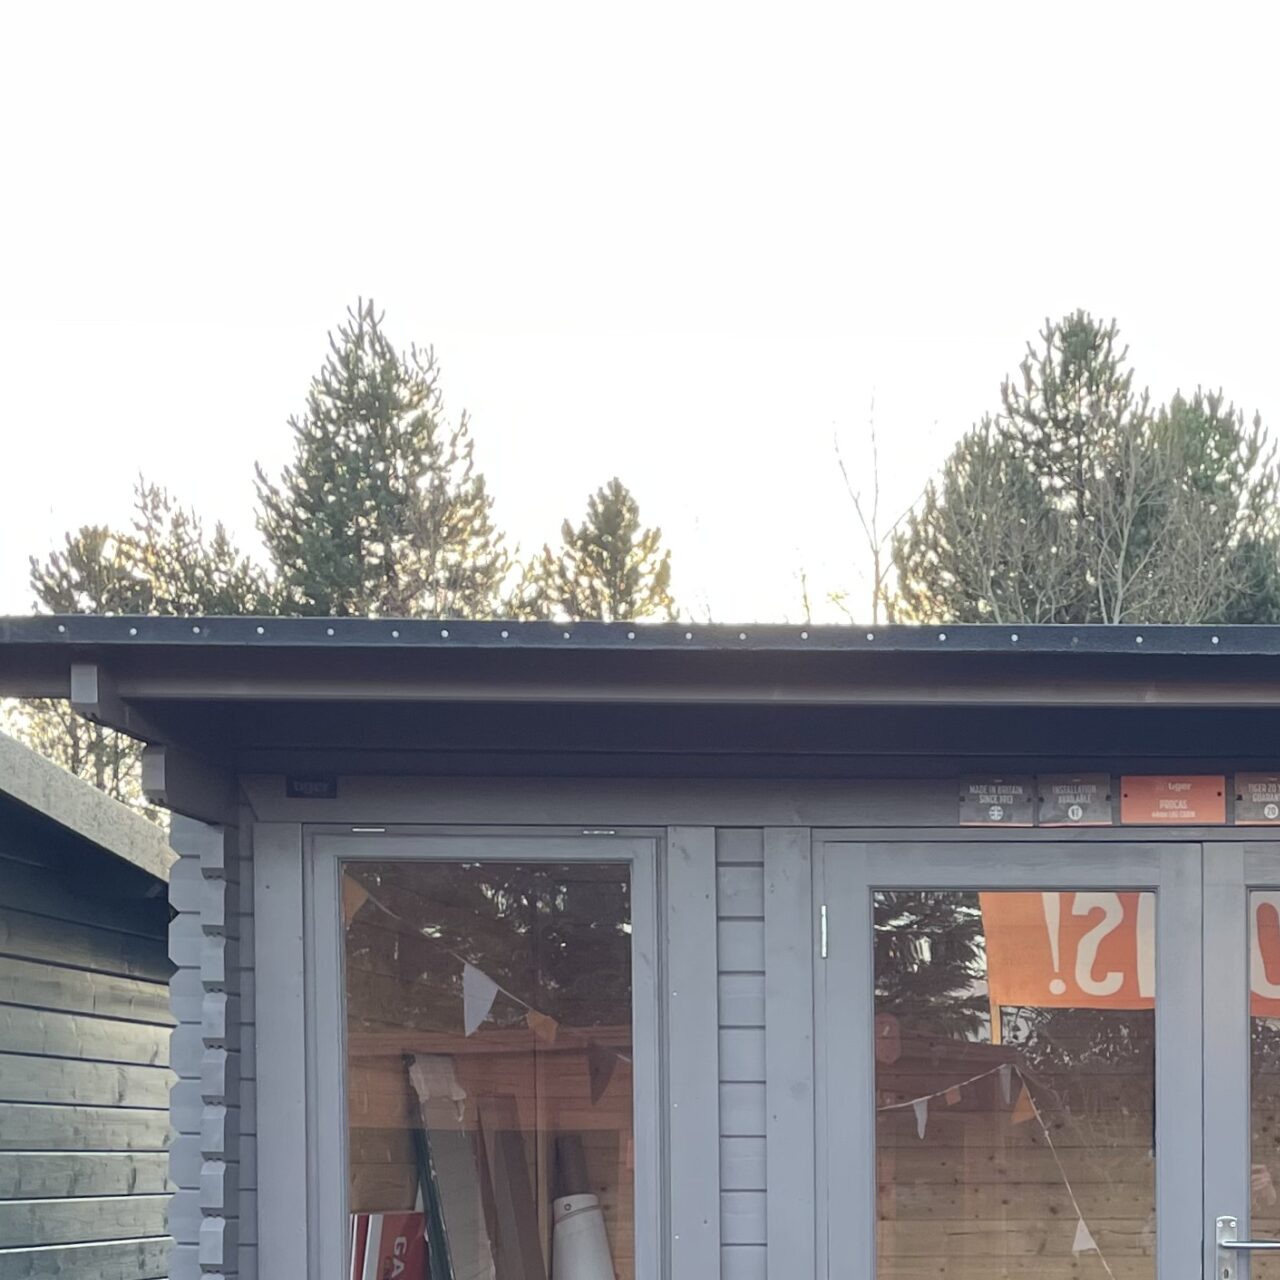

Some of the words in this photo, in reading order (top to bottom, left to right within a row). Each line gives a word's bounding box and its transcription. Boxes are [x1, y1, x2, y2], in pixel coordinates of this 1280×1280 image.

[969, 785, 987, 794] MADE
[988, 785, 996, 794] IN
[997, 785, 1023, 795] BRITAIN
[1052, 784, 1097, 794] INSTALLATION
[1248, 783, 1267, 793] TIGER
[1267, 783, 1277, 793] 20
[1058, 794, 1091, 804] AVAILABLE
[1266, 806, 1277, 816] 20
